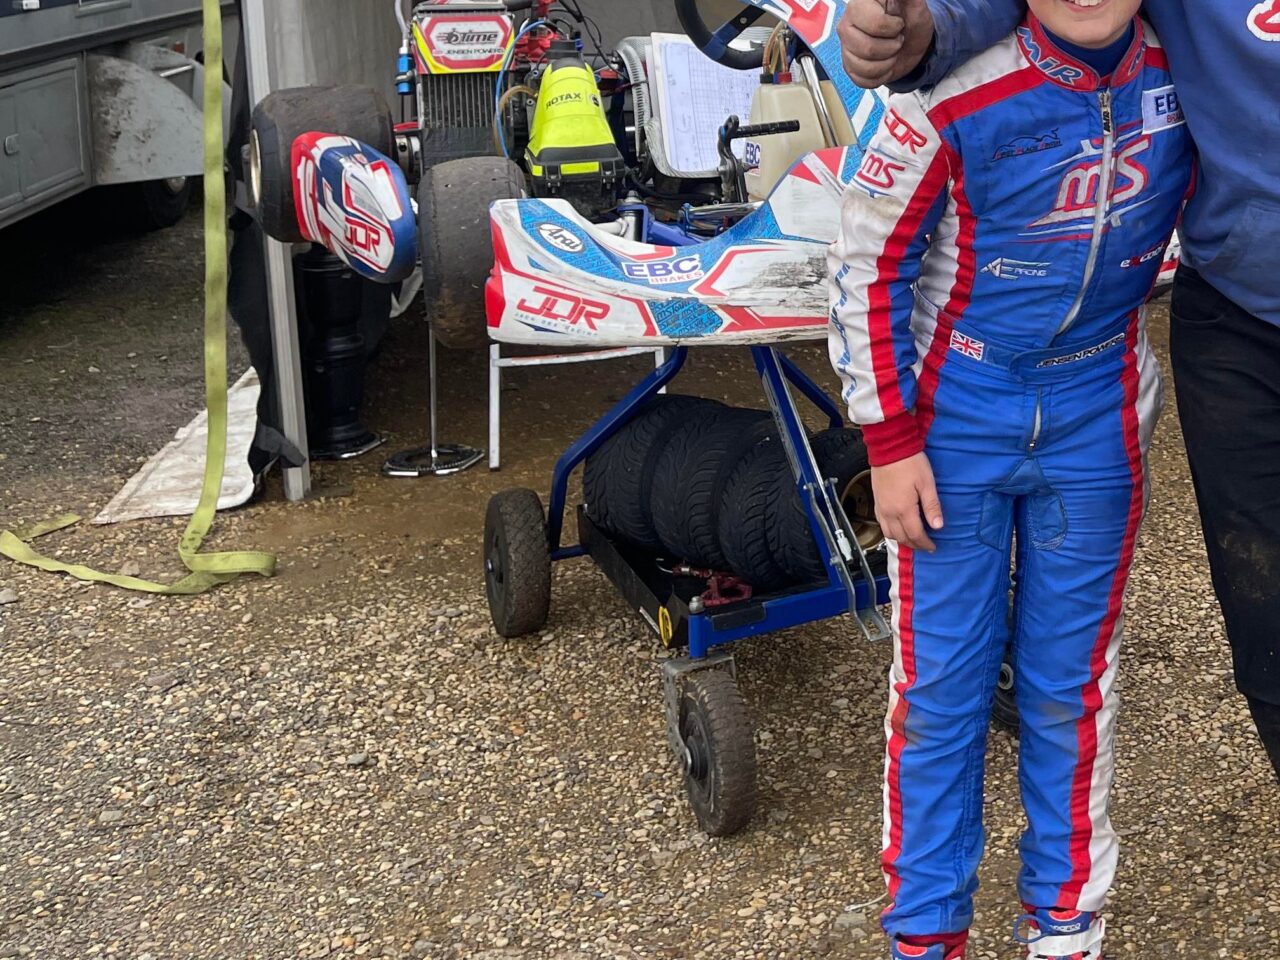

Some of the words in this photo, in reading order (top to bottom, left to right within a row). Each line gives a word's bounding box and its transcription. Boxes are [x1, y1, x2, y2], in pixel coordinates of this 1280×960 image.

[546, 92, 581, 109] ROTAX
[1154, 91, 1180, 116] EB
[745, 142, 761, 163] EBC
[544, 224, 580, 251] Arai
[624, 256, 700, 279] EBC
[650, 271, 703, 284] BRAKES
[516, 285, 611, 331] JDR
[1036, 352, 1082, 369] JENSEN
